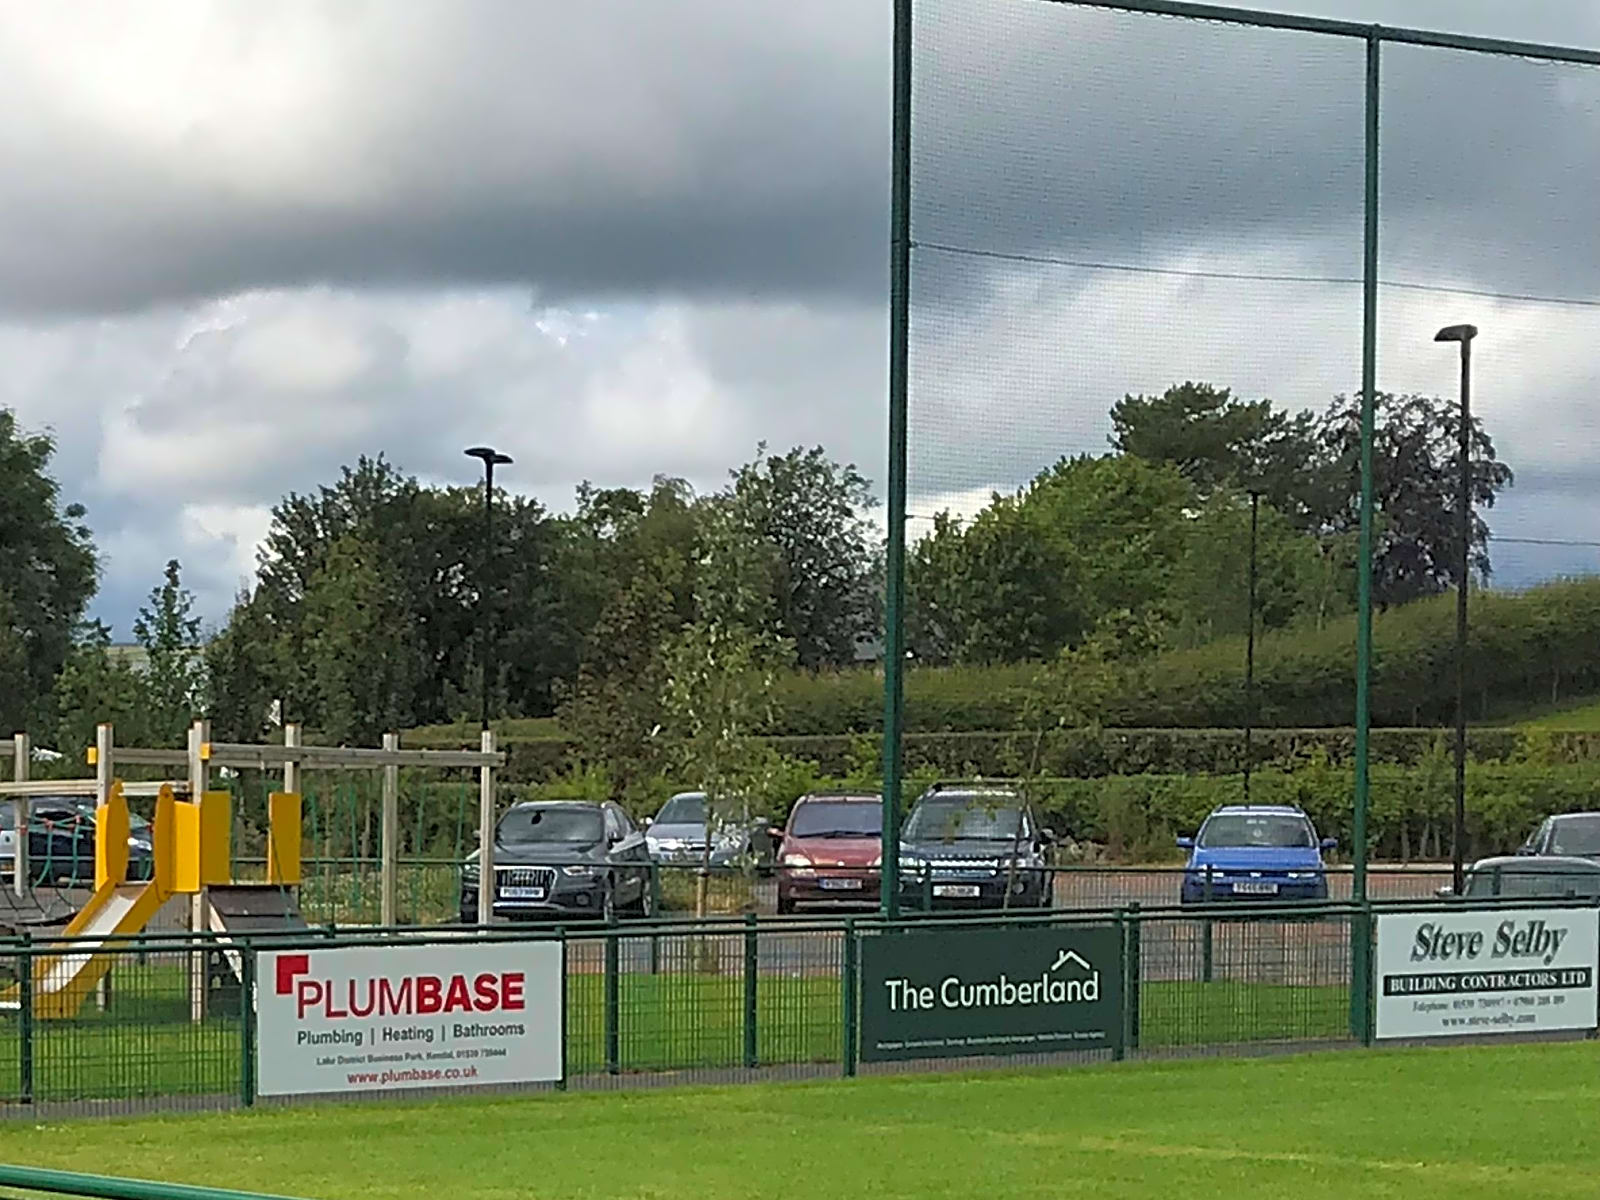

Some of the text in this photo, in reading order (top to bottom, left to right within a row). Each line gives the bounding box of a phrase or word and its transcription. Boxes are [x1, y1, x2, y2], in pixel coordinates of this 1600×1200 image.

[1409, 919, 1567, 965] Steve Selby
[297, 972, 525, 1019] PLUMBASE
[885, 971, 1099, 1010] The Cumberland
[1390, 970, 1586, 992] BUILDING CONTRACTORS LTD
[297, 1022, 525, 1045] Plumbing Heating Bathrooms
[347, 1065, 478, 1084] www.plumbase.co.uk
